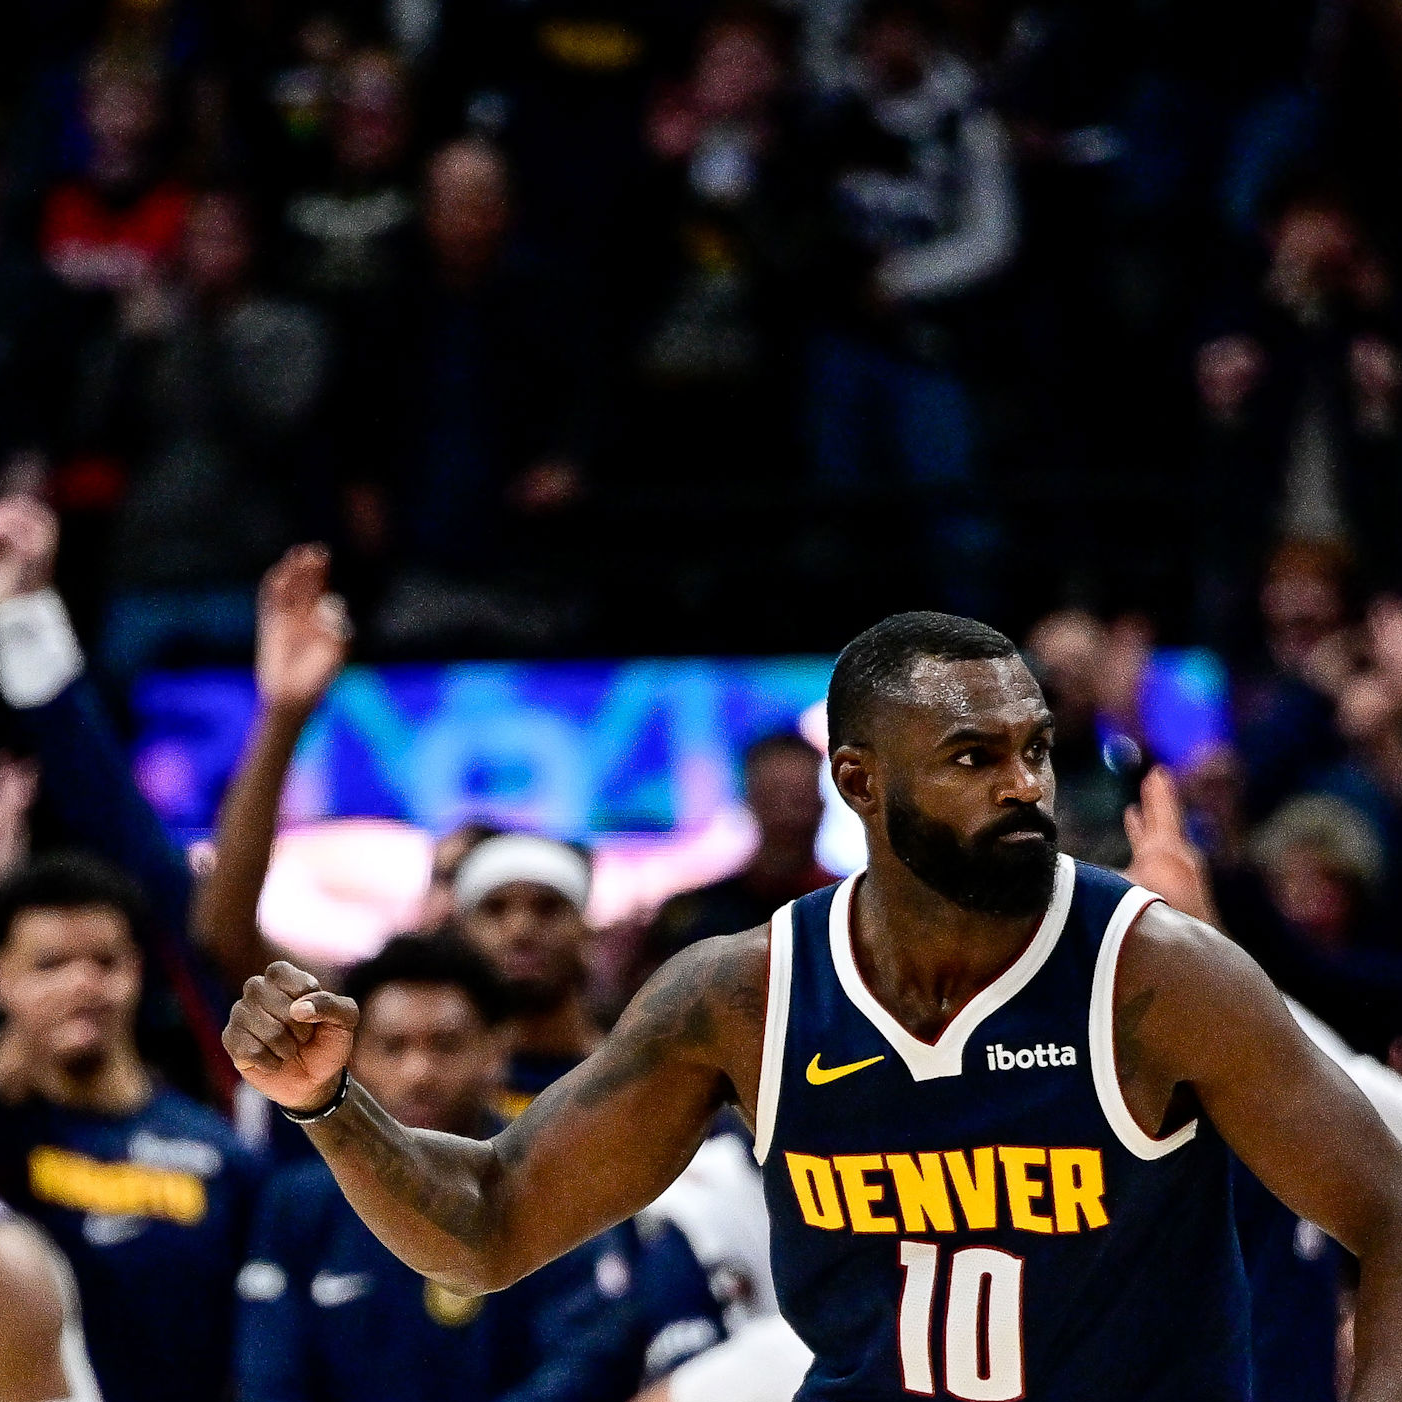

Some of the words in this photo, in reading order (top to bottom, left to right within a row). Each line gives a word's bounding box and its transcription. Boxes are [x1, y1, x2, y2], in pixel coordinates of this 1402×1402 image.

[985, 1043, 1077, 1071] ibotta
[784, 1144, 1110, 1235] DENVER
[898, 1238, 1026, 1402] 10
